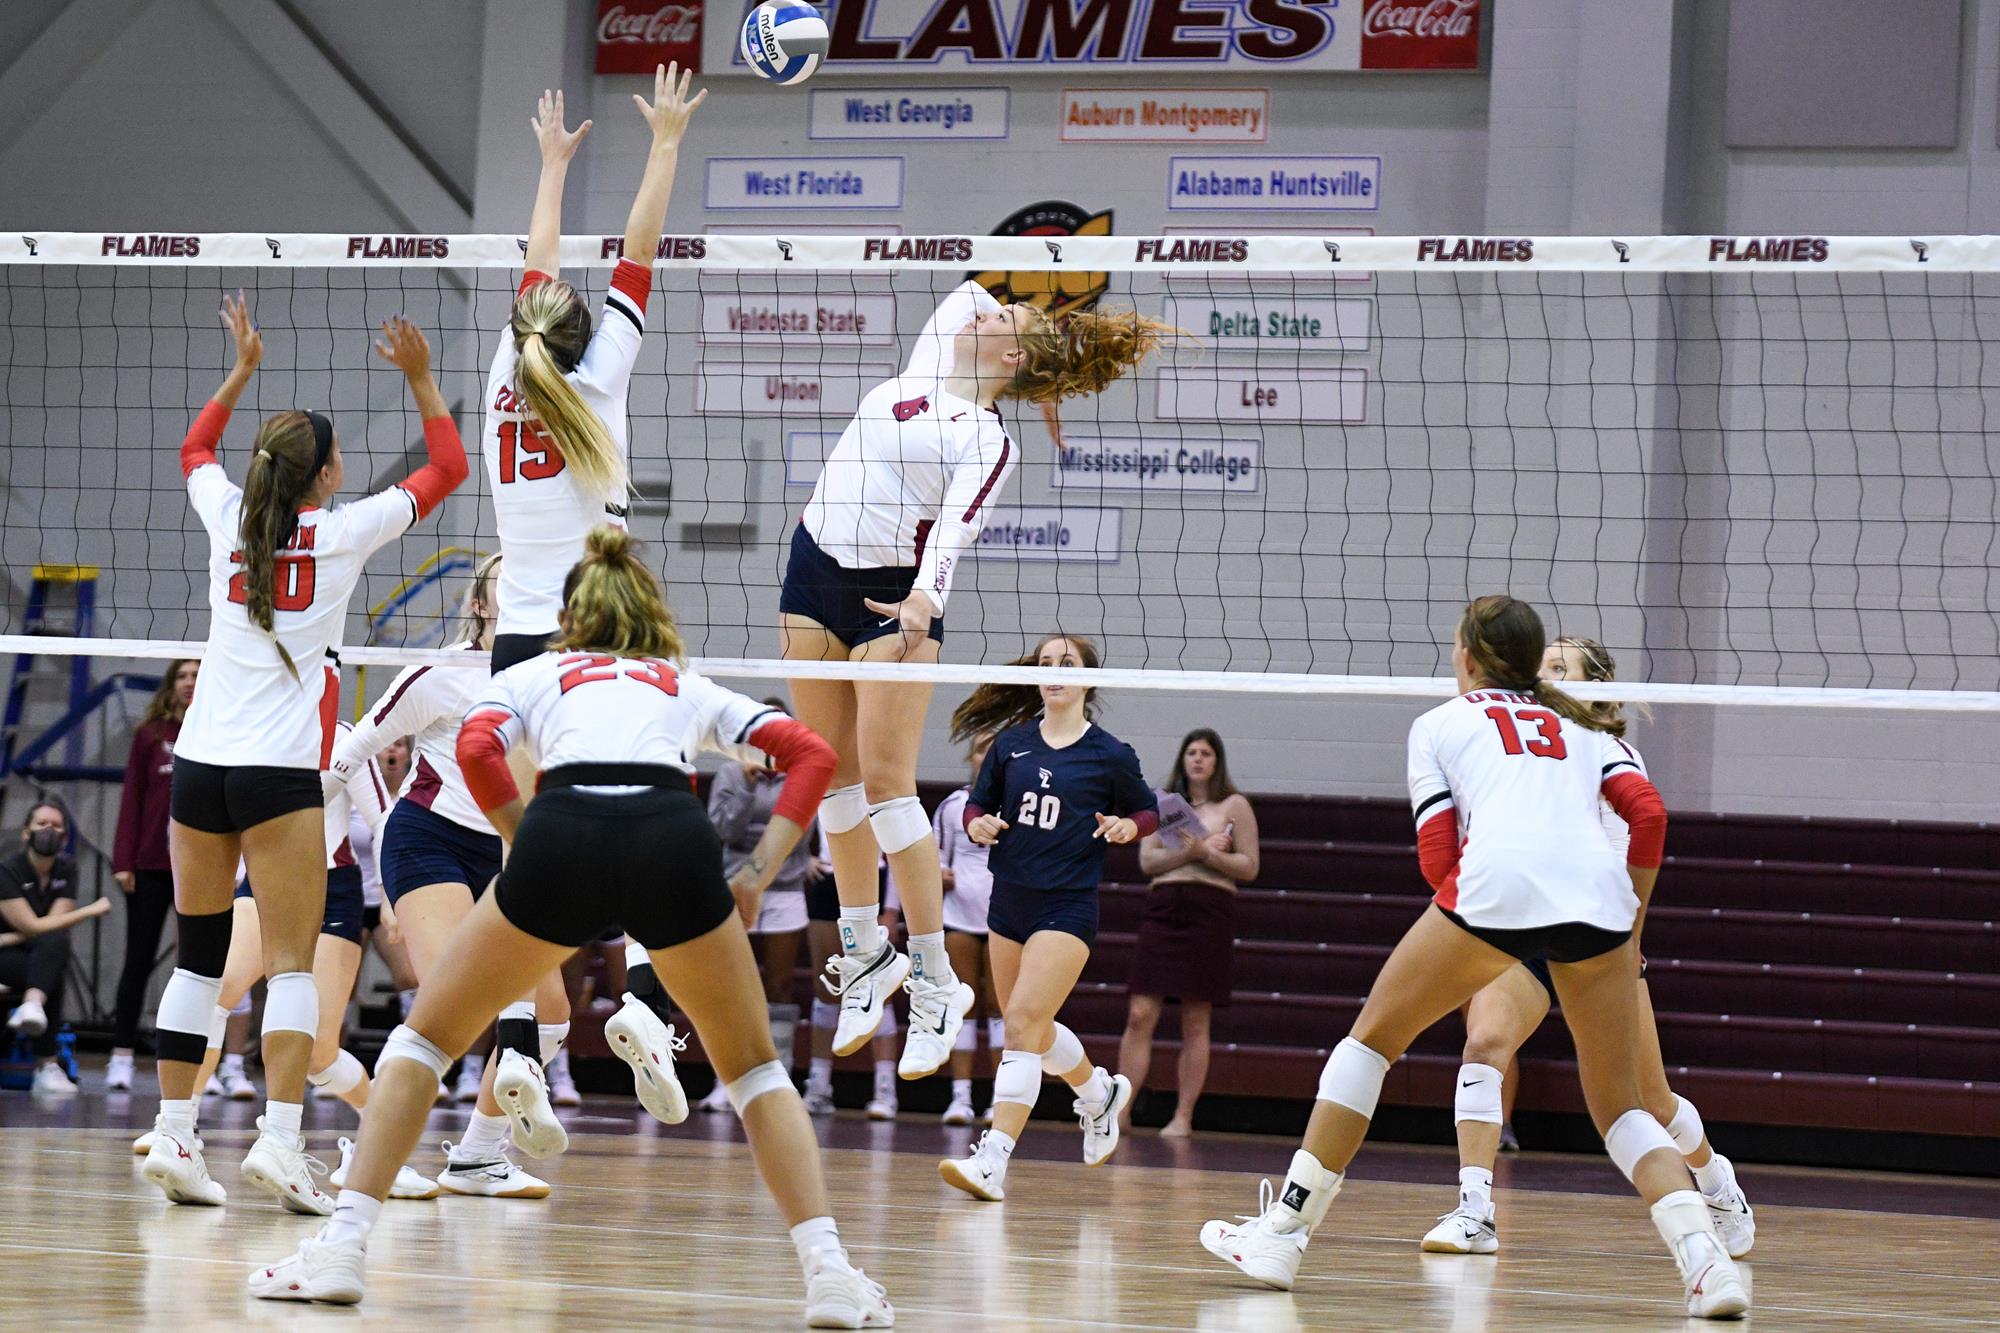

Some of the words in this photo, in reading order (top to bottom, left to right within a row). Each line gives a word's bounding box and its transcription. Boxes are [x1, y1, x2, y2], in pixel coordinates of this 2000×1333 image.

[761, 14, 779, 61] molten
[845, 98, 891, 123] West
[898, 98, 973, 128] Georgia
[1068, 101, 1135, 126] Auburn
[1141, 101, 1261, 131] Montgomery
[745, 171, 791, 196] West
[799, 171, 863, 196] Florida
[1176, 171, 1263, 196] Alabama
[1271, 171, 1372, 197] Huntsville
[101, 235, 200, 258] FLAMES
[346, 236, 449, 259] FLAMES
[601, 237, 706, 260] FMES
[863, 237, 973, 262] FLAMES
[1135, 239, 1249, 263] FLAMES
[1416, 238, 1534, 263] FLAMES
[1708, 237, 1830, 263] FLAMES
[728, 307, 808, 332] Valdosta
[817, 307, 866, 332] State
[1209, 310, 1259, 338] Delta
[1267, 311, 1321, 338] State
[764, 376, 819, 400] Union
[1241, 381, 1278, 407] Lee
[497, 419, 566, 484] 15
[1060, 447, 1168, 478] Mississippi
[1175, 450, 1252, 481] College
[978, 520, 1071, 546] ontevallo
[557, 654, 679, 697] 23
[1484, 705, 1568, 761] 13
[1018, 791, 1061, 830] 20
